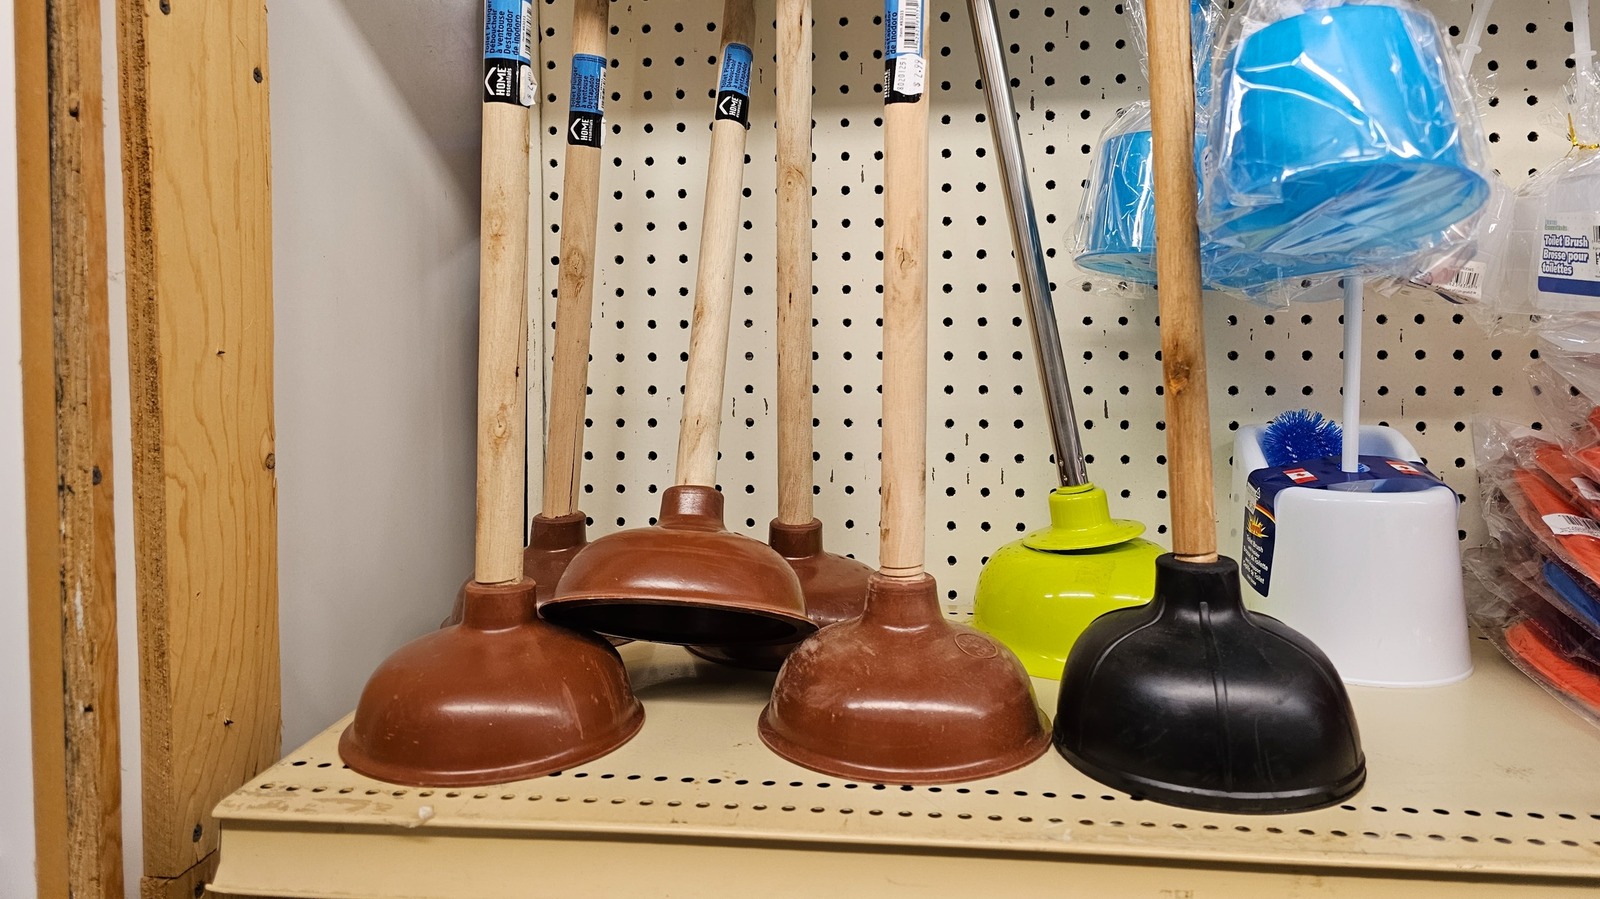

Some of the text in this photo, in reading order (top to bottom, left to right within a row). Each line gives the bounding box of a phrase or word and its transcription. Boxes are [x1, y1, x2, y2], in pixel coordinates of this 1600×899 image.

[490, 9, 498, 53] Débouchoir
[497, 11, 505, 47] ventouse
[504, 10, 514, 54] Destapador
[512, 14, 521, 55] de inodoro
[890, 45, 896, 54] de
[496, 67, 507, 96] HOME
[587, 74, 595, 109] Destapador
[729, 96, 739, 116] HOME
[580, 118, 589, 141] HOME
[1544, 234, 1589, 249] Toilet Brush
[1541, 261, 1574, 276] toilettes
[1543, 248, 1589, 264] Brosse pour
